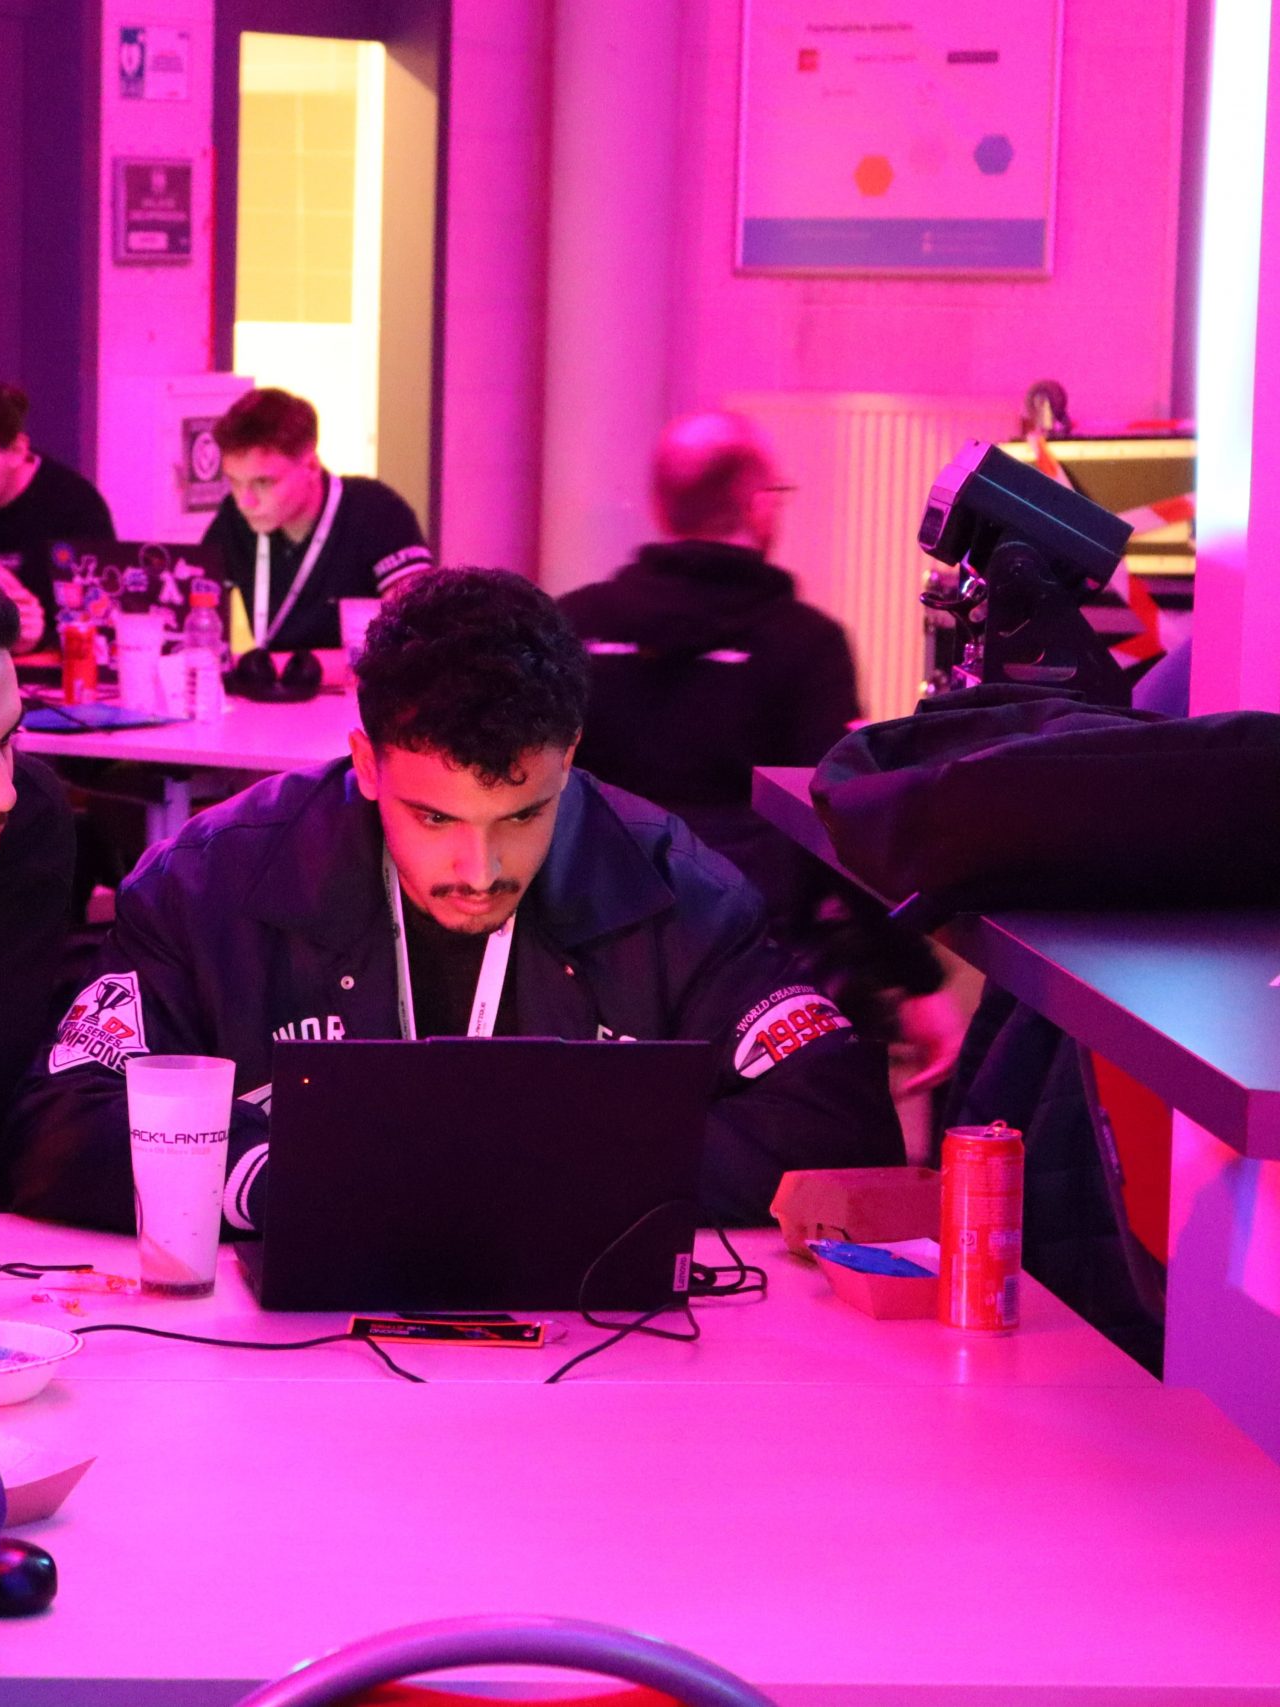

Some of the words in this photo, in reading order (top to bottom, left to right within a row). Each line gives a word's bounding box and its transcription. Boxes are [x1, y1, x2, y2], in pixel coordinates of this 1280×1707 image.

[736, 999, 770, 1032] WORLD
[755, 1002, 838, 1063] 1996
[61, 1029, 131, 1071] MPIONS
[84, 1025, 123, 1049] SERIES
